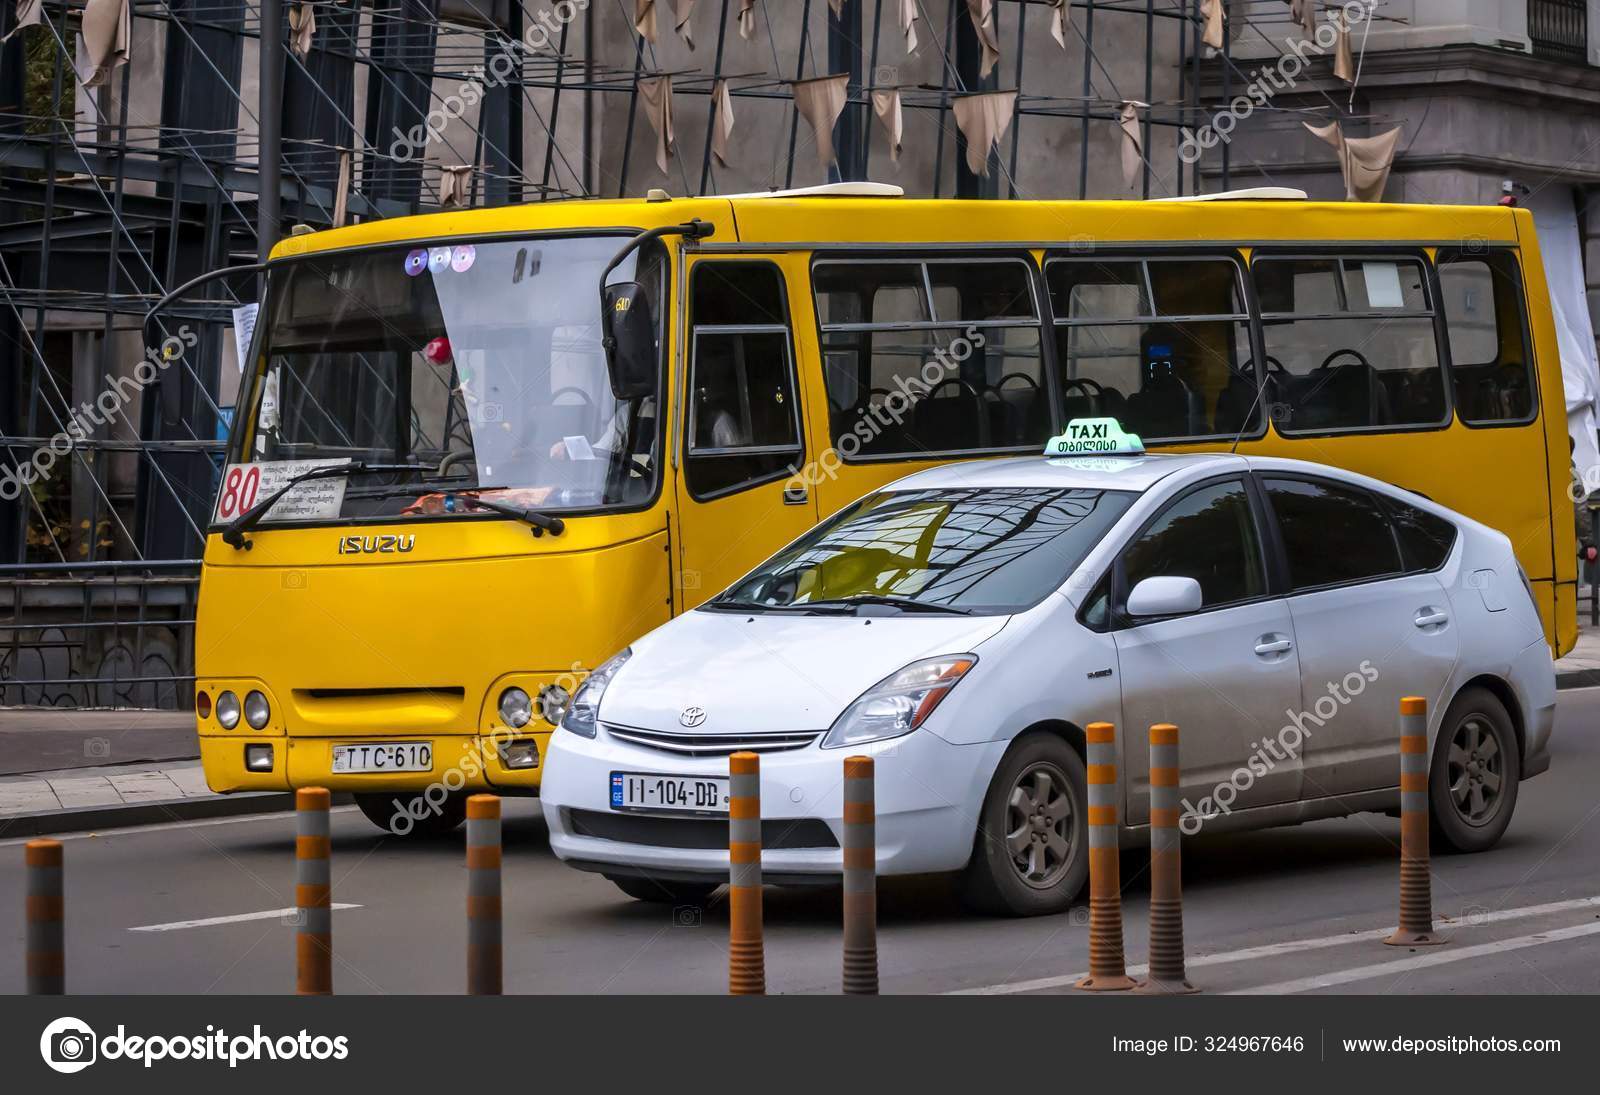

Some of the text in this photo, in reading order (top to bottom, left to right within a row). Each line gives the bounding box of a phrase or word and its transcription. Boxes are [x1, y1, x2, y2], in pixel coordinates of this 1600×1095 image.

[1070, 424, 1107, 439] TAXI
[1058, 440, 1117, 452] თბილისი
[220, 466, 260, 518] 80
[338, 535, 416, 554] ISUZU
